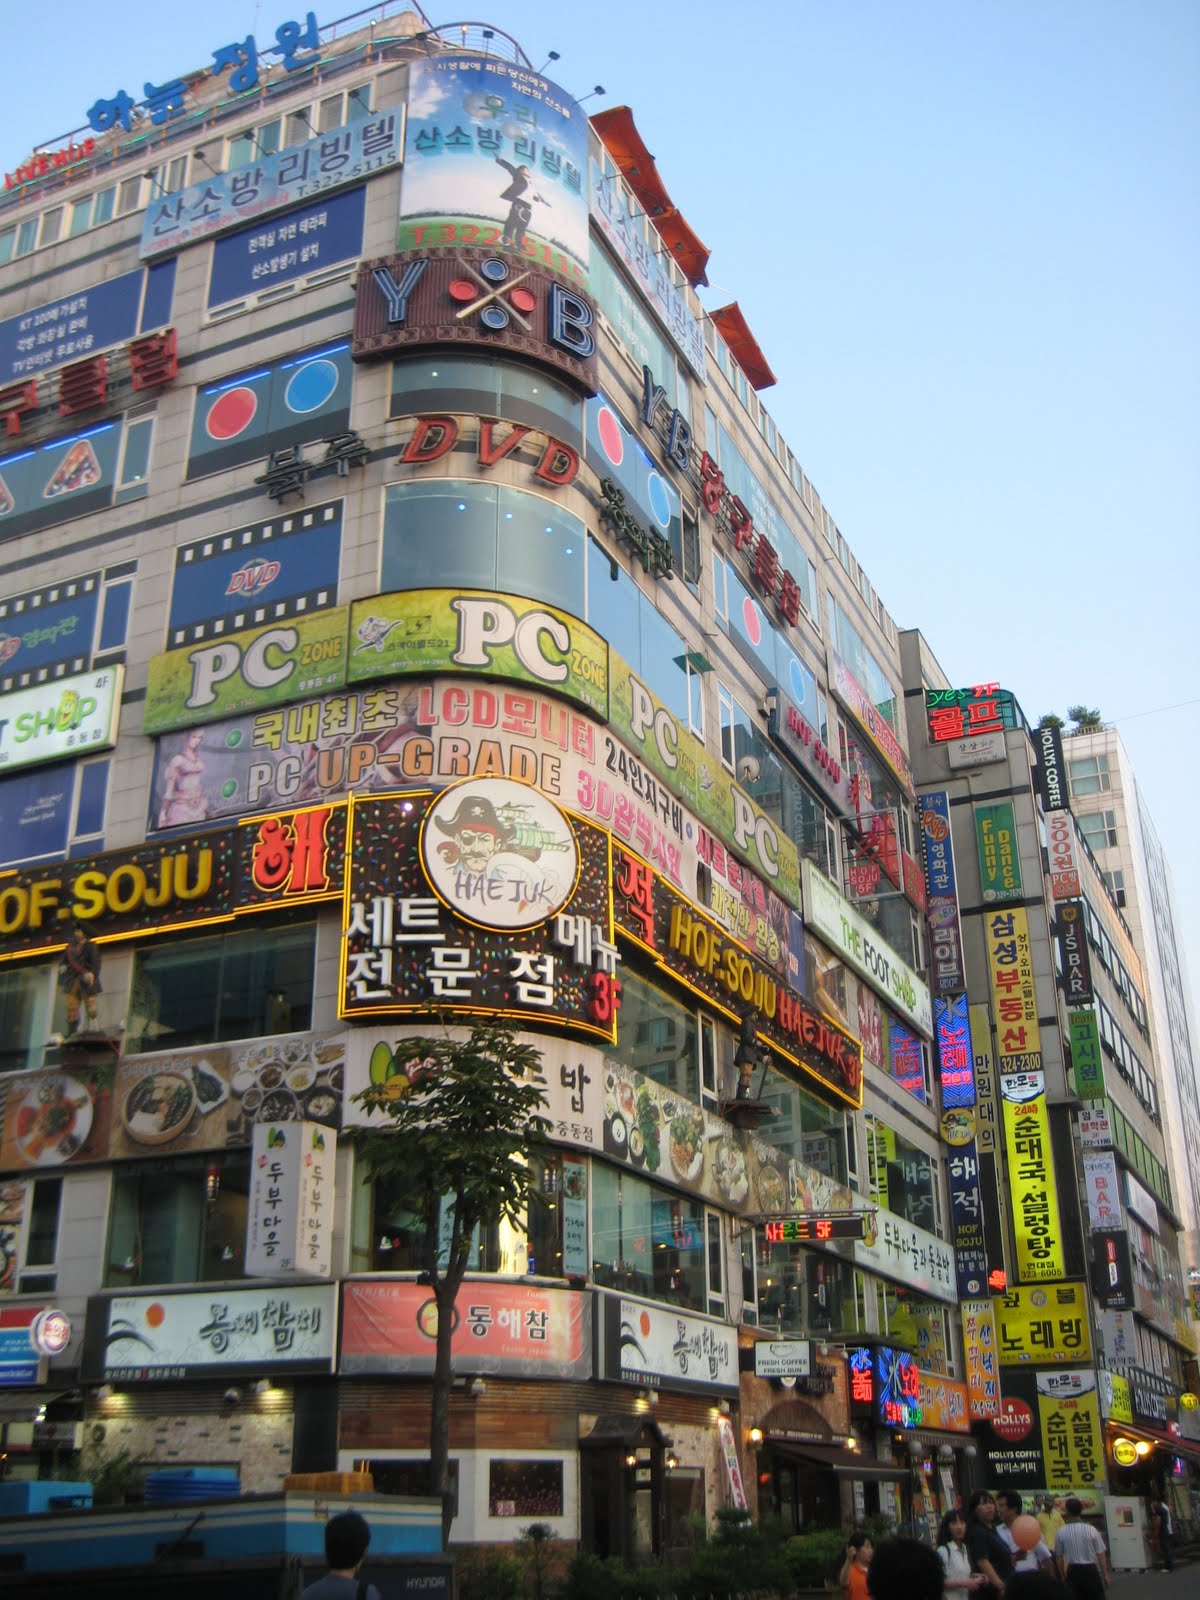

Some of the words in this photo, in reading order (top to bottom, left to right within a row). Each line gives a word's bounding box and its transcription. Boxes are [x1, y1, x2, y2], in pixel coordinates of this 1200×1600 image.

[152, 168, 264, 237] 산소방
[278, 114, 395, 187] 리빙텔
[413, 125, 503, 152] 산소방
[514, 138, 582, 196] 리빙텔
[372, 258, 431, 323] Y
[548, 281, 597, 358] B
[394, 414, 581, 487] DVD
[225, 560, 281, 596] DVD
[450, 596, 571, 685] PC
[571, 649, 607, 694] ZONE
[96, 675, 110, 689] 4F
[185, 627, 299, 711] PC
[300, 636, 342, 666] ZONE
[14, 693, 99, 744] SHOP
[926, 687, 968, 708] yes
[252, 688, 399, 752] 국내최초
[417, 686, 597, 765] LCD모니터
[628, 673, 679, 770] PC
[930, 700, 1005, 742] 골프
[787, 705, 812, 747] HOF
[814, 738, 842, 785] SOJU
[1041, 727, 1056, 768] HOLLYS
[248, 755, 303, 805] PC
[316, 735, 562, 797] UP-GRADE
[1046, 768, 1062, 809] COFFEE
[730, 782, 780, 879] PC
[922, 809, 949, 843] DVD
[253, 806, 331, 896] 해
[850, 865, 877, 877] HOF
[930, 843, 949, 889] 영화관
[981, 818, 997, 882] Funny
[998, 829, 1014, 889] Dance
[851, 873, 878, 884] SOJU
[859, 883, 872, 893] 5F
[346, 896, 446, 949] 세트
[553, 914, 622, 974] 메뉴
[840, 913, 863, 961] THE
[863, 936, 891, 990] FOOT
[934, 928, 960, 979] 라이브
[346, 946, 555, 1007] 전문점
[1068, 954, 1084, 993] BAR
[940, 1025, 969, 1068] 노래
[1001, 1053, 1041, 1073] 324-2300
[1076, 1024, 1099, 1082] 고시원
[556, 1119, 594, 1143] 중동점
[950, 1156, 979, 1218] 해적
[1094, 1176, 1112, 1218] BAR
[816, 1220, 833, 1239] 5F
[956, 1236, 984, 1248] SOJU
[957, 1224, 979, 1234] HOF
[1020, 1268, 1063, 1279] 323-6005
[466, 1303, 570, 1343] 동해참
[1000, 1318, 1082, 1351] 노래방
[757, 1359, 781, 1367] FRESH
[781, 1358, 808, 1366] COFFEE
[993, 1412, 1031, 1425] HOLLYS
[988, 1450, 1014, 1459] HOLLYS
[1015, 1450, 1041, 1459] COFFEE
[1046, 1411, 1073, 1483] 순대국
[1071, 1410, 1098, 1483] 설렁탕
[406, 1575, 446, 1589] HYUNDAI
